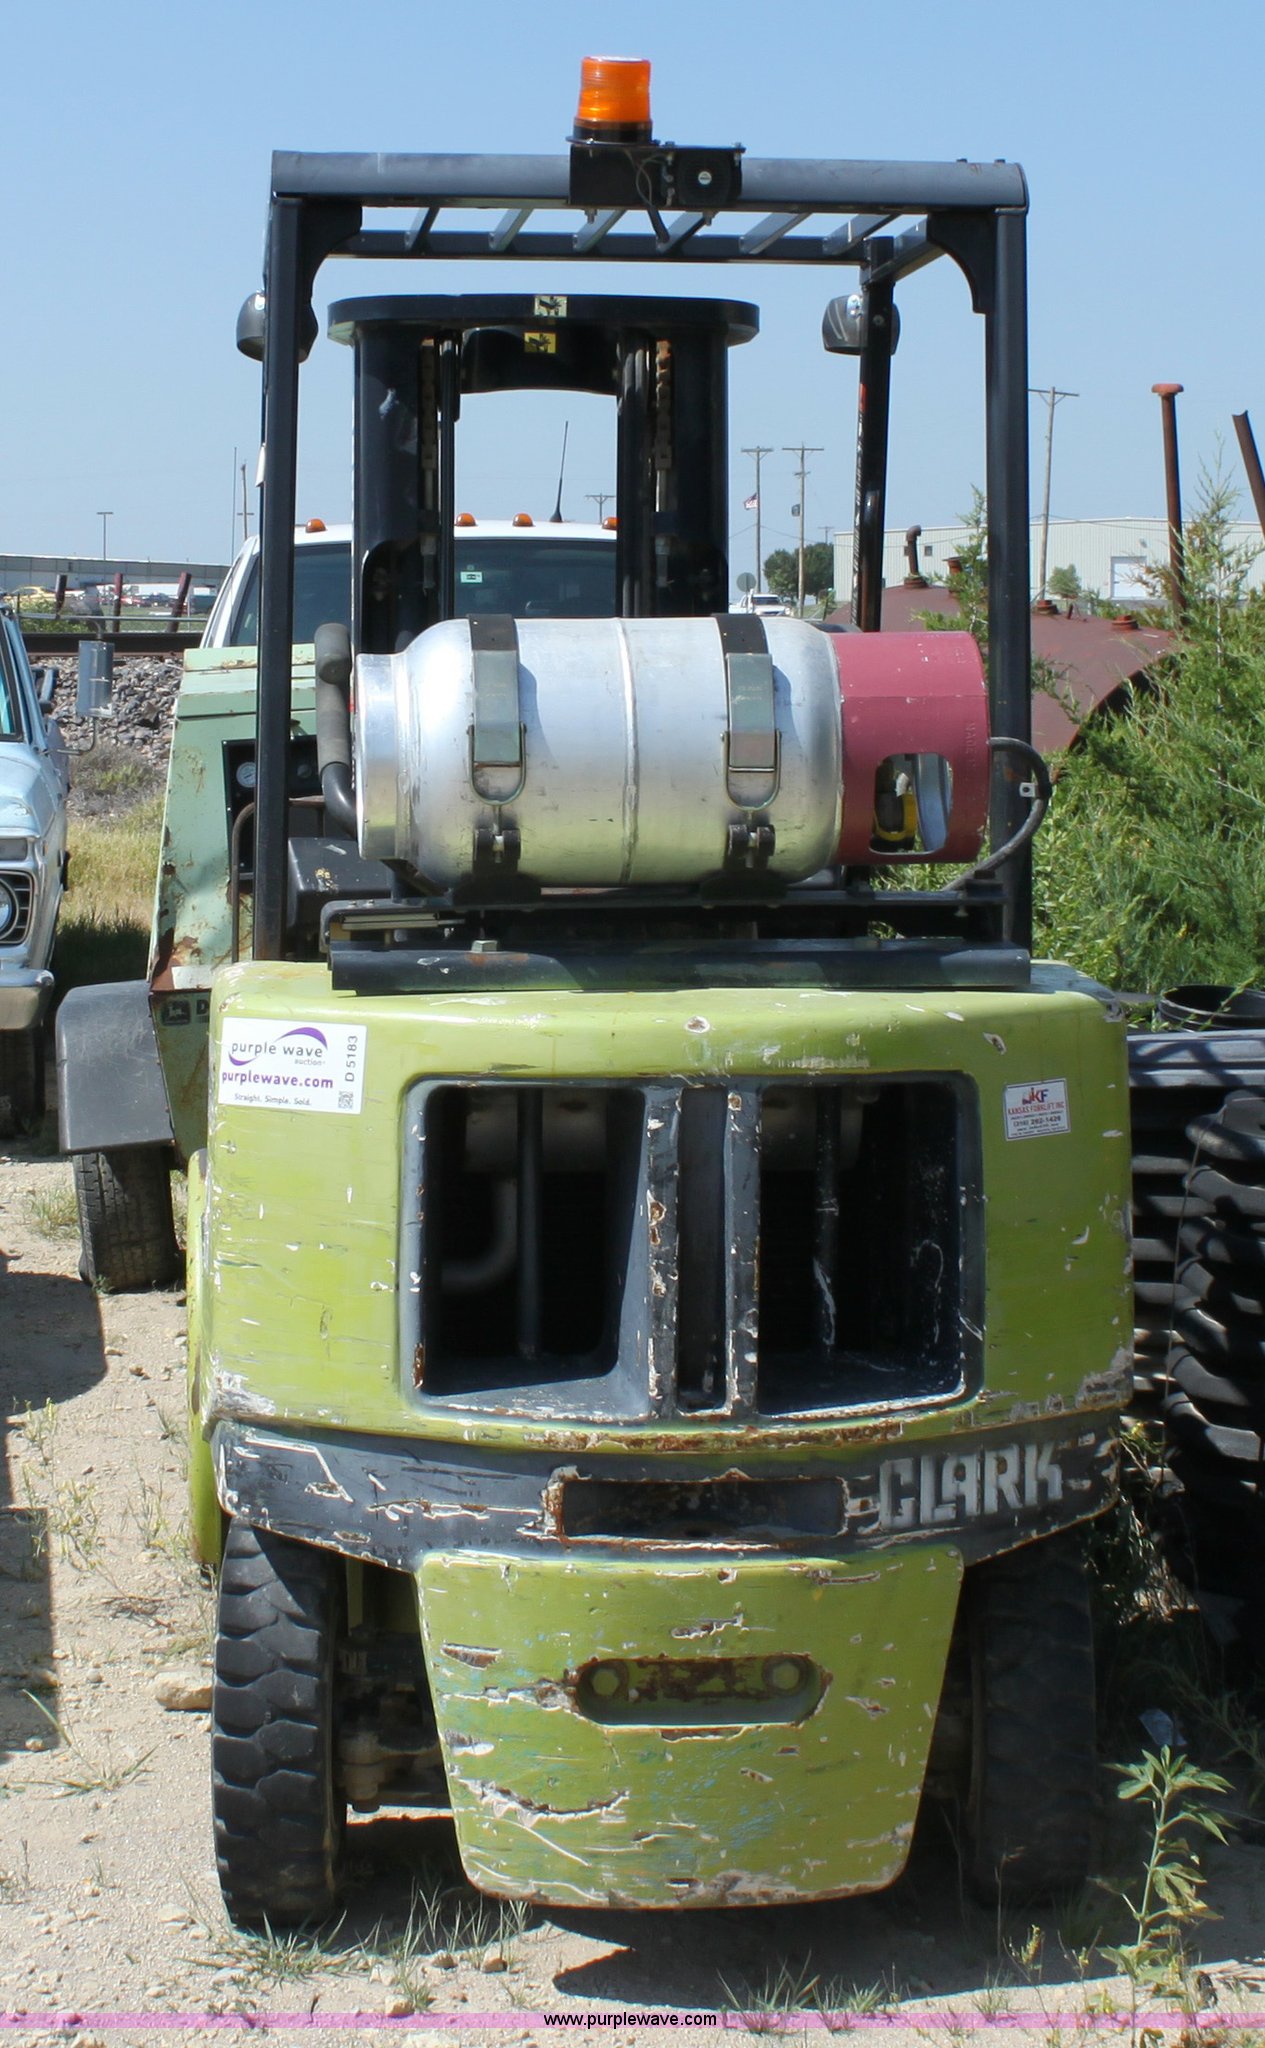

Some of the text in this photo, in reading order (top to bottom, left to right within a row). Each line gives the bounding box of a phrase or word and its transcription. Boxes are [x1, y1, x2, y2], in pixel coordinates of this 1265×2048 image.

[231, 1041, 323, 1058] purple wave
[222, 1070, 334, 1089] purplewave.com
[879, 1442, 1063, 1529] CLARK
